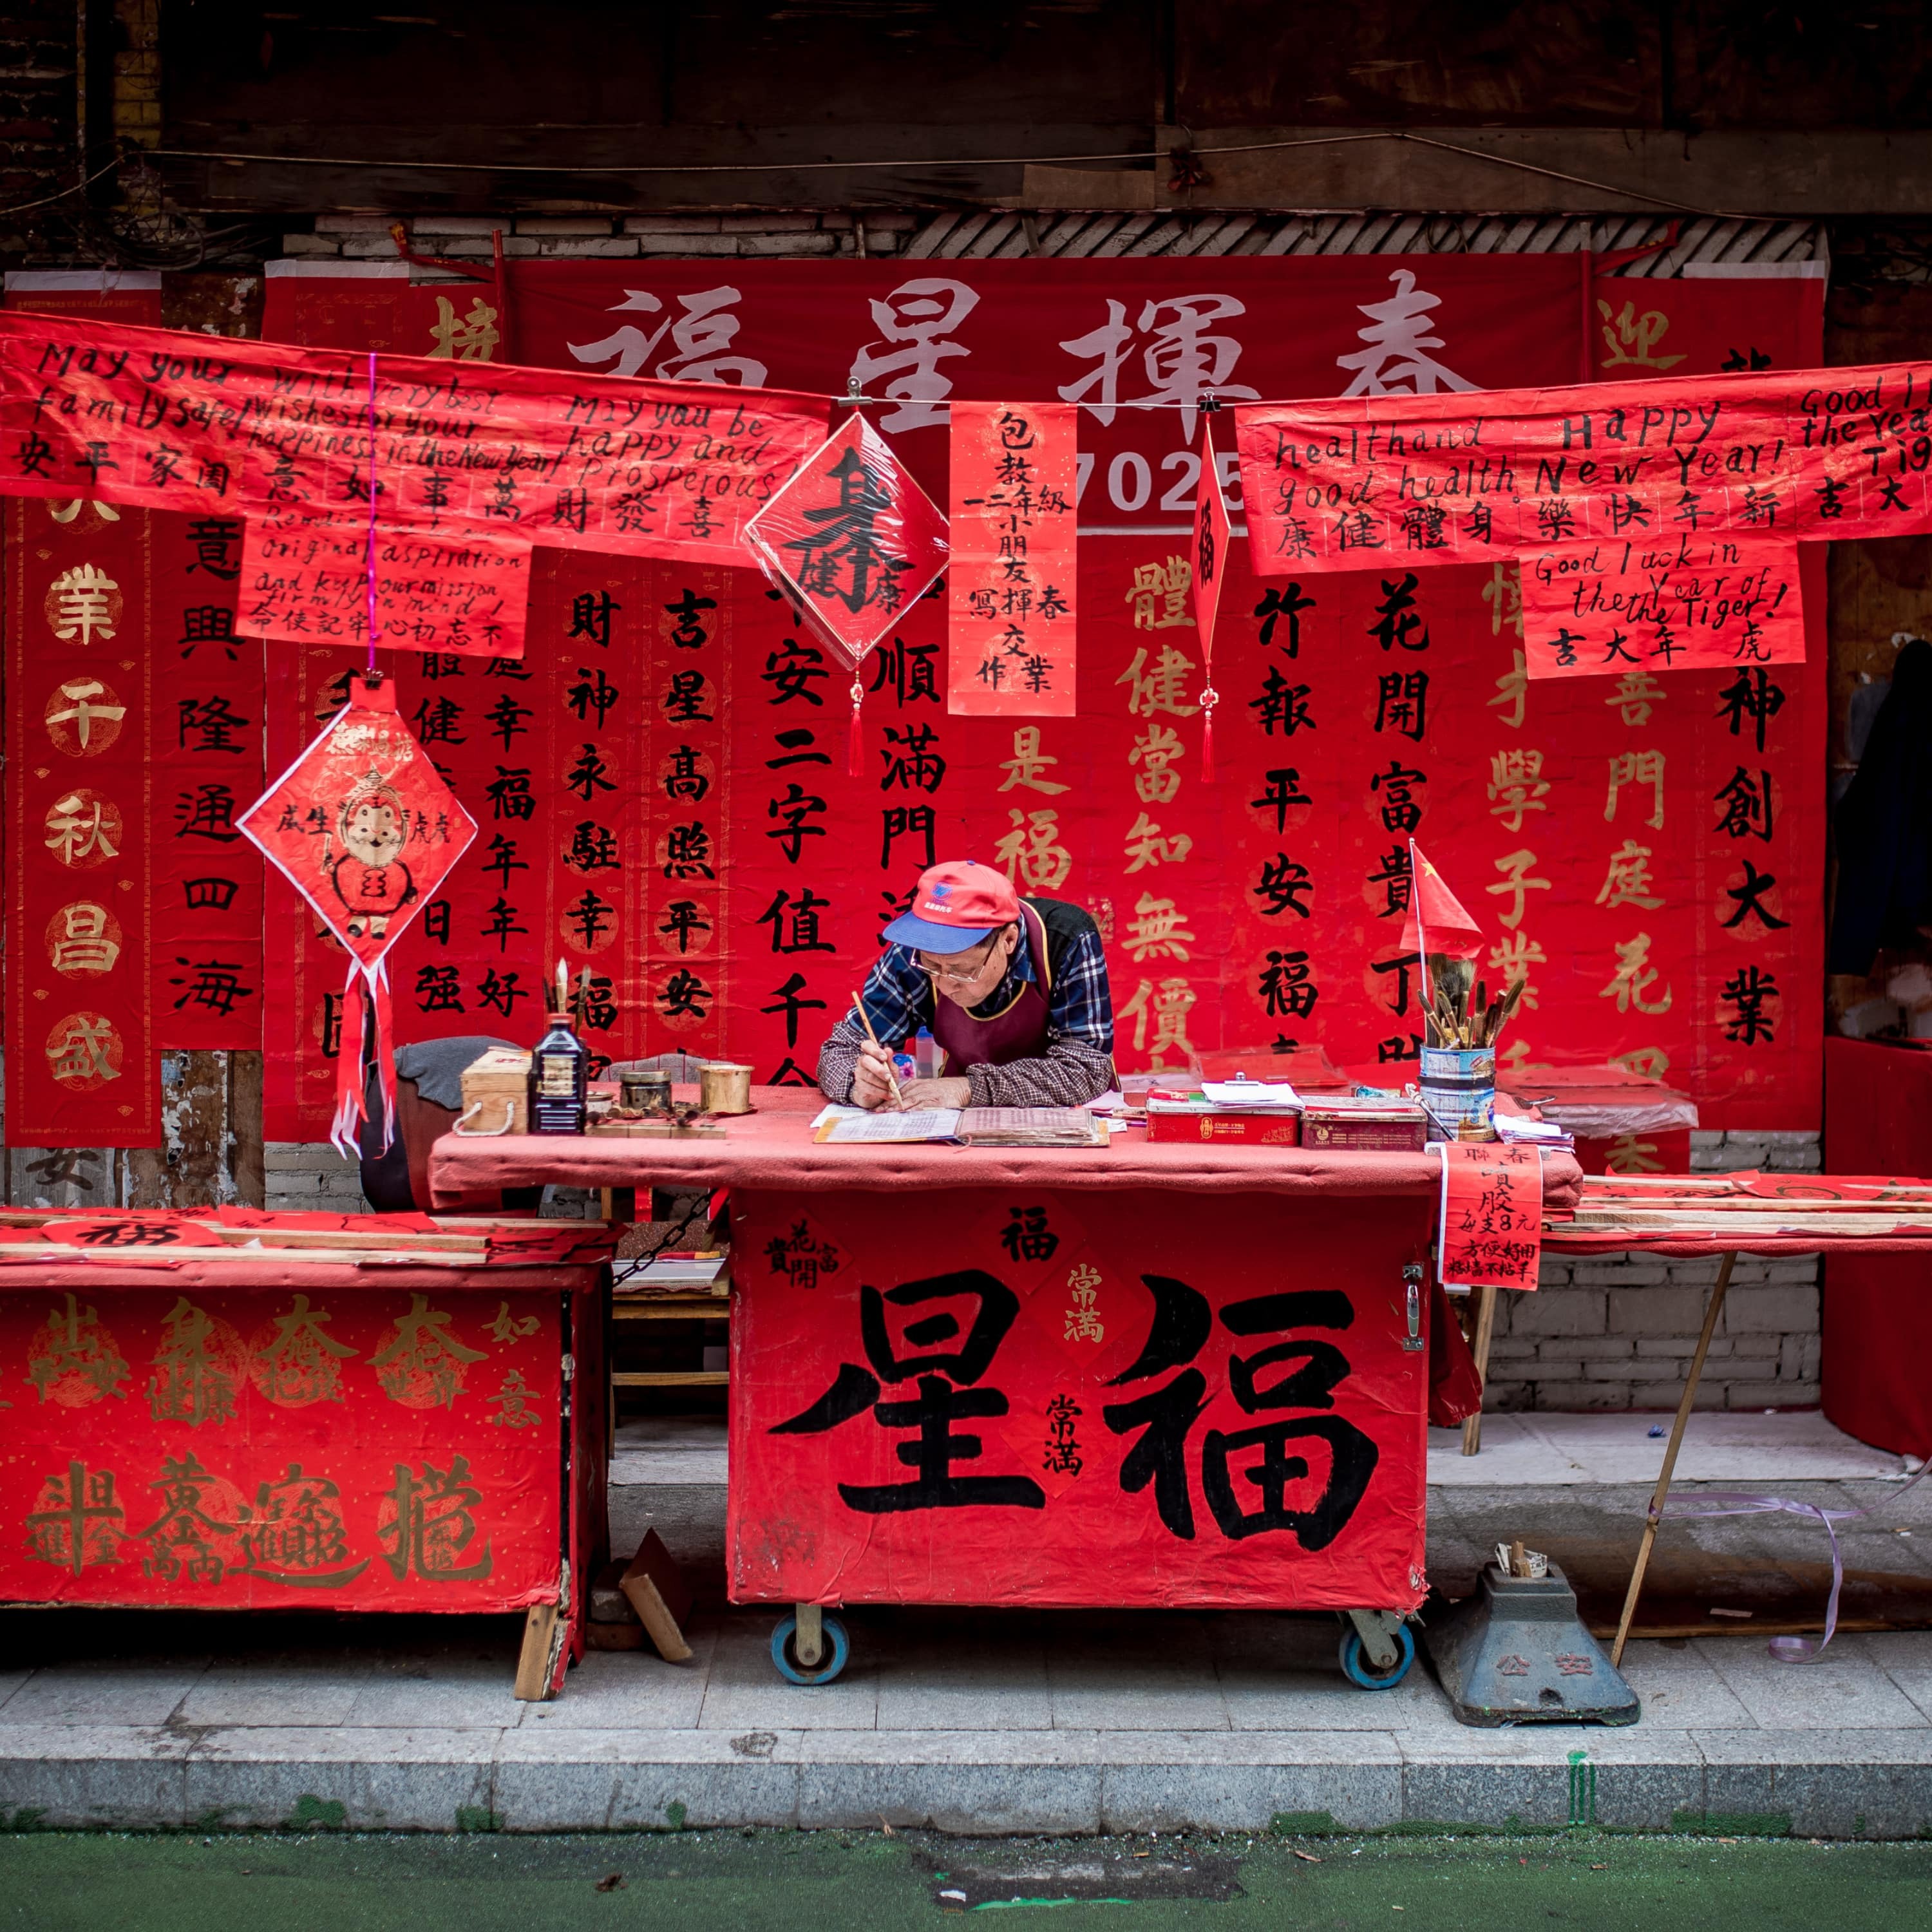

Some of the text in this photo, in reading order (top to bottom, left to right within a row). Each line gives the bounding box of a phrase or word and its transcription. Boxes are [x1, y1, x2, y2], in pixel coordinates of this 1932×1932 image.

[1596, 299, 1687, 369] 迎
[37, 343, 236, 386] May your
[33, 385, 169, 430] family
[565, 394, 643, 426] May
[727, 403, 765, 437] be
[1801, 375, 1883, 418] Good
[566, 426, 773, 466] happy and
[1275, 416, 1483, 470] health and
[1562, 400, 1721, 450] Happy
[1801, 413, 1858, 448] the
[1273, 469, 1378, 515] good
[1535, 439, 1785, 495] New Year!
[1535, 533, 1740, 587] Good luck in
[1573, 580, 1629, 618] the
[1740, 567, 1772, 602] of
[1681, 583, 1788, 630] Tiger!
[173, 517, 253, 1018] 意興隆通四海
[1115, 555, 1206, 1075] 體健當知無價
[1000, 1206, 1059, 1262] 福
[481, 1301, 542, 1429] 如意
